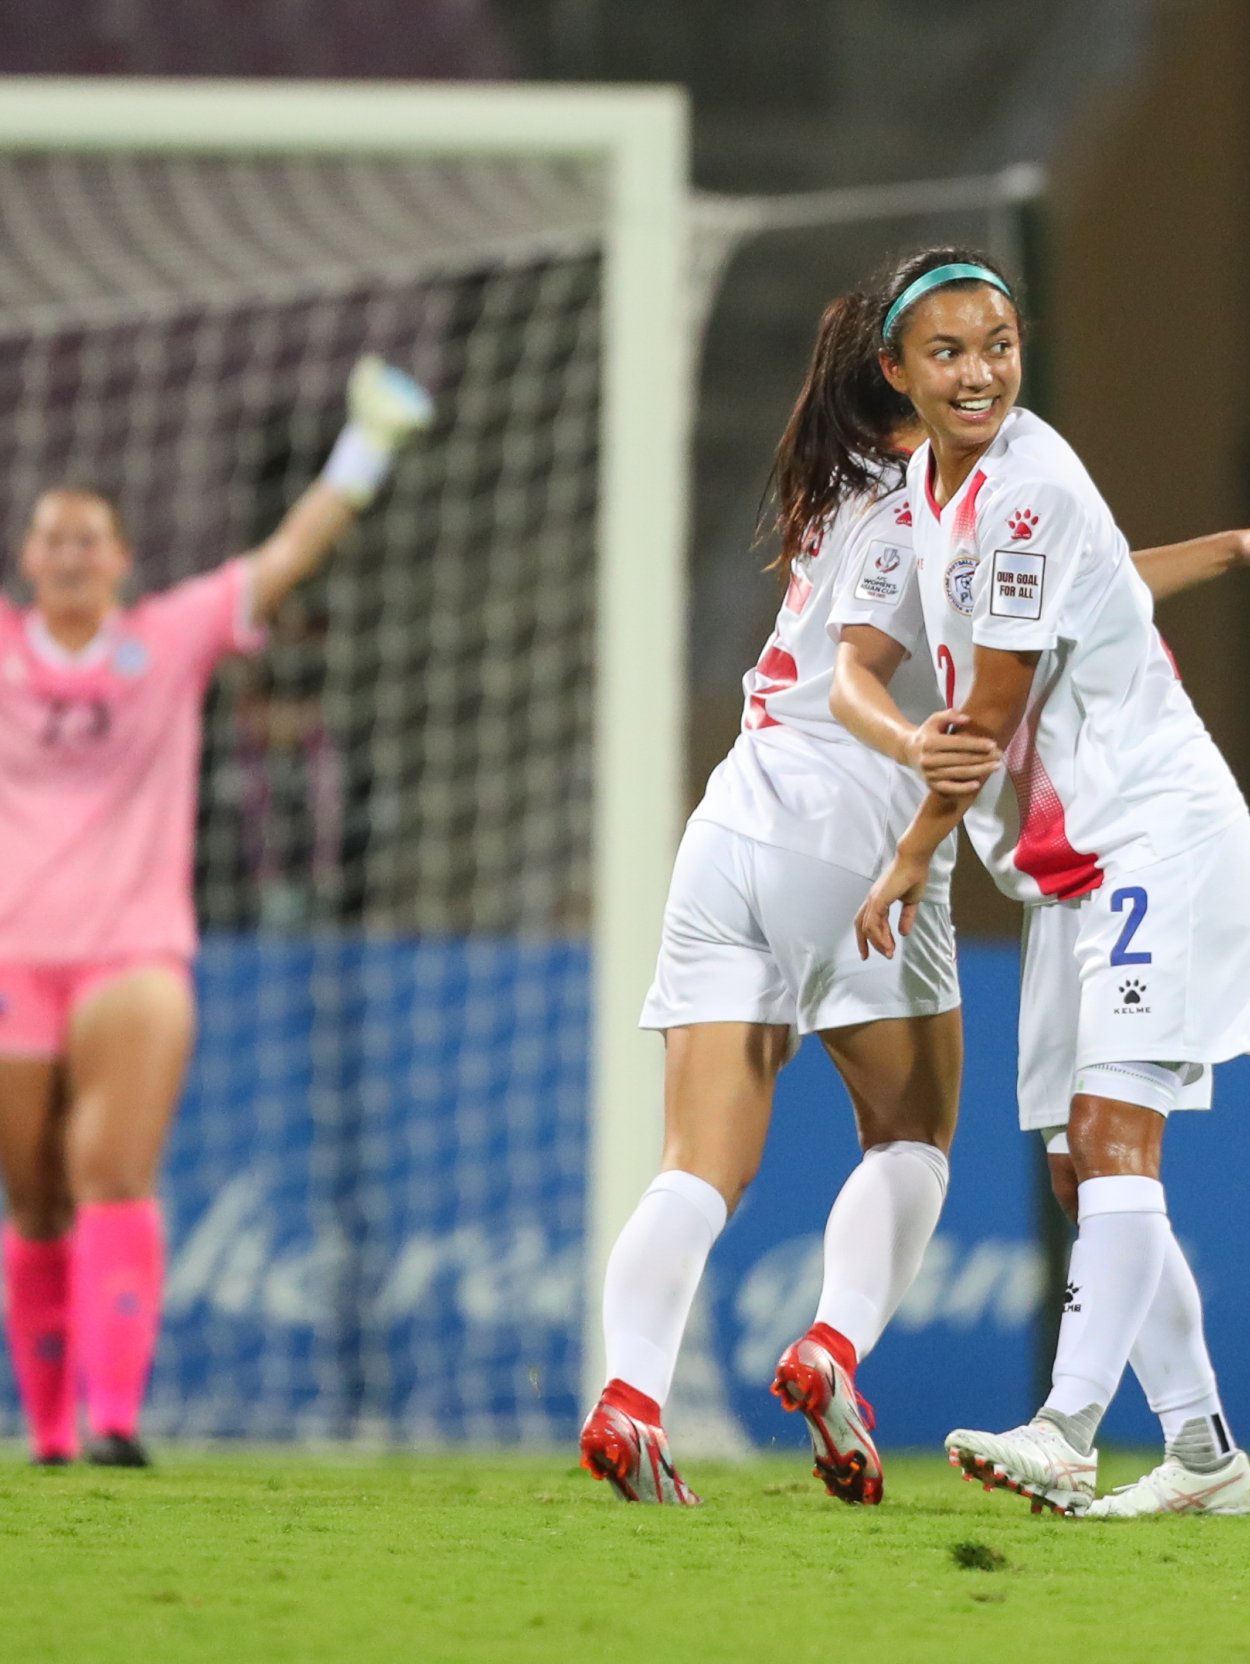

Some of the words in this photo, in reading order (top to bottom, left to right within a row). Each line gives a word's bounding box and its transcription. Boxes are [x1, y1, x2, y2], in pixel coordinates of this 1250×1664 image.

[863, 578, 897, 590] WOMEN'S
[997, 571, 1014, 583] OUR
[1016, 573, 1039, 586] GOAL
[999, 585, 1016, 597] FOR
[1018, 586, 1033, 599] ALL
[1110, 886, 1152, 967] 2
[1113, 1006, 1152, 1014] KELME
